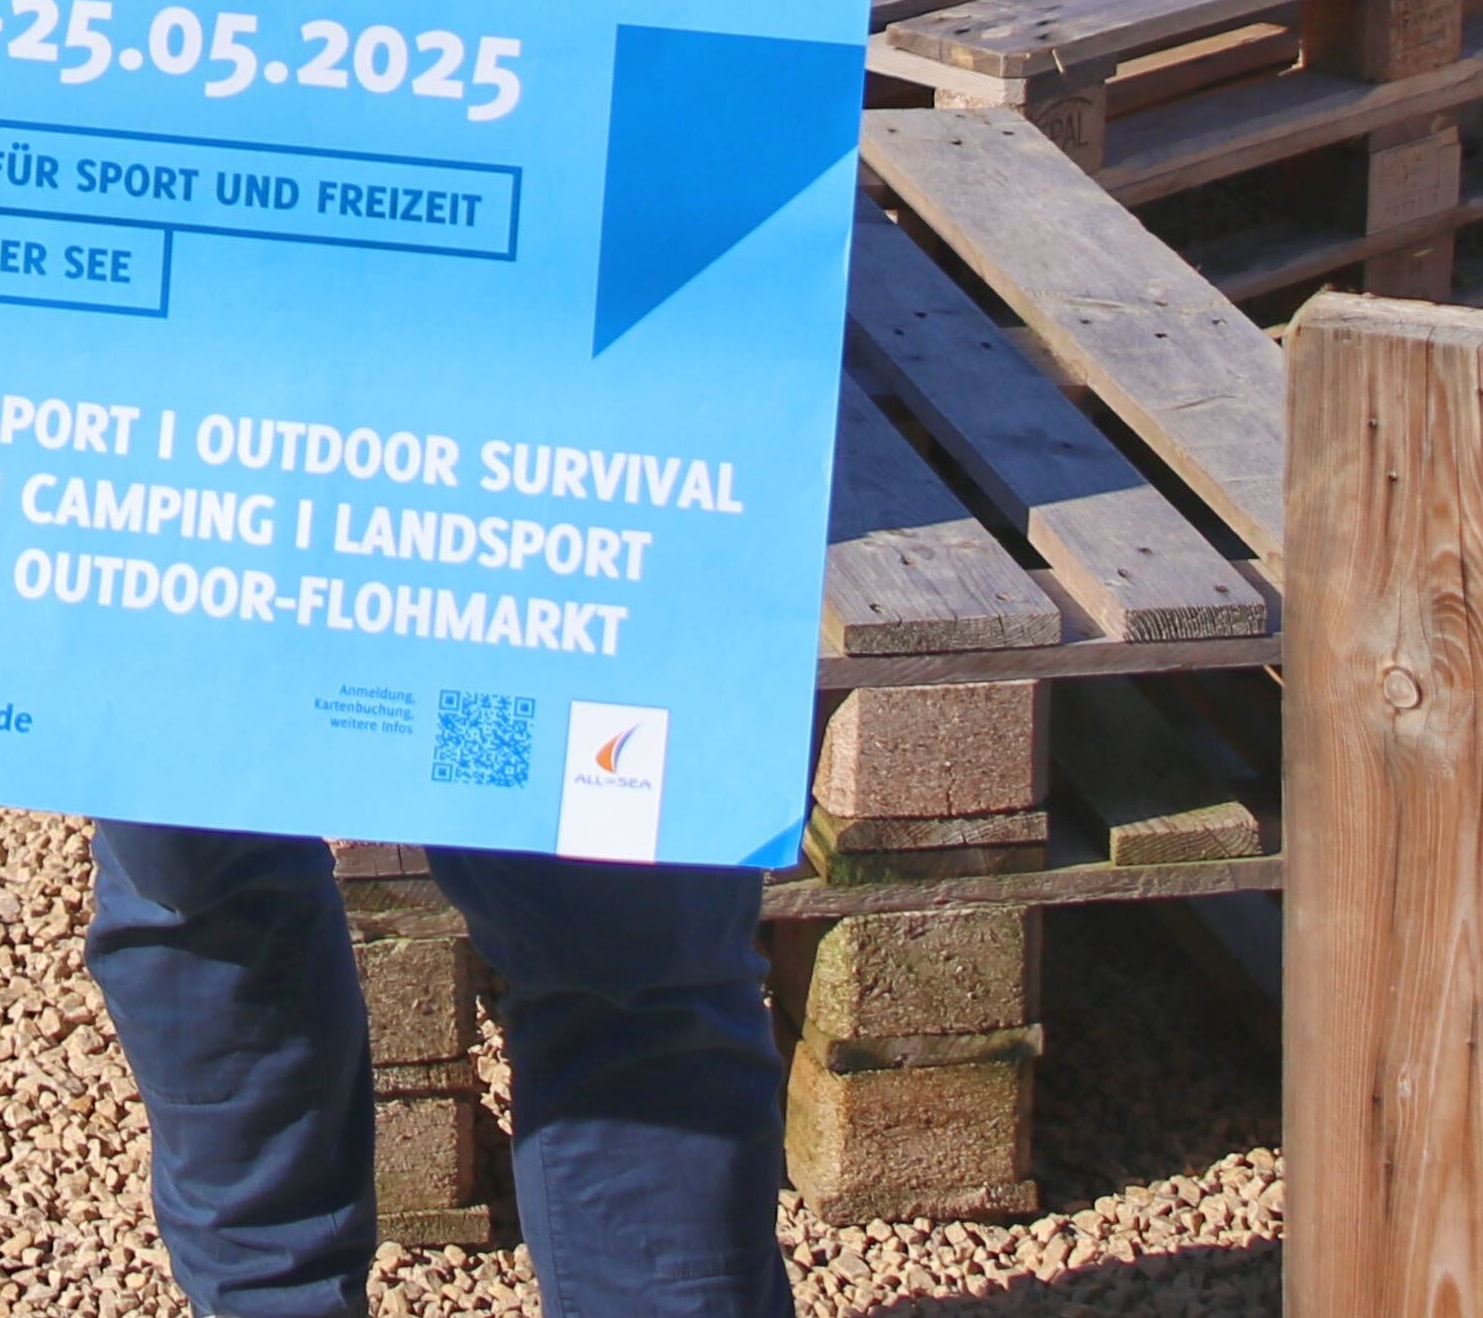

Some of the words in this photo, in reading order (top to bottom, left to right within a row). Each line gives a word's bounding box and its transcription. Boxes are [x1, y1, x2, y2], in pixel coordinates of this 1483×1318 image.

[75, 158, 200, 203] SPORT
[215, 171, 300, 211] UND
[317, 180, 483, 228] FREIZEIT
[64, 245, 133, 284] SEE
[196, 413, 461, 488] OUTDOOR
[479, 439, 744, 515] SURVIVAL
[20, 472, 275, 547] CAMPING
[334, 501, 653, 582] LANDSPORT
[13, 547, 629, 657] OUTDOOR-FLOHMARKT
[314, 697, 414, 722] Kartenbuchung,
[339, 684, 416, 705] Anmeldung,
[330, 716, 378, 732] weitere
[381, 720, 413, 735] Infos
